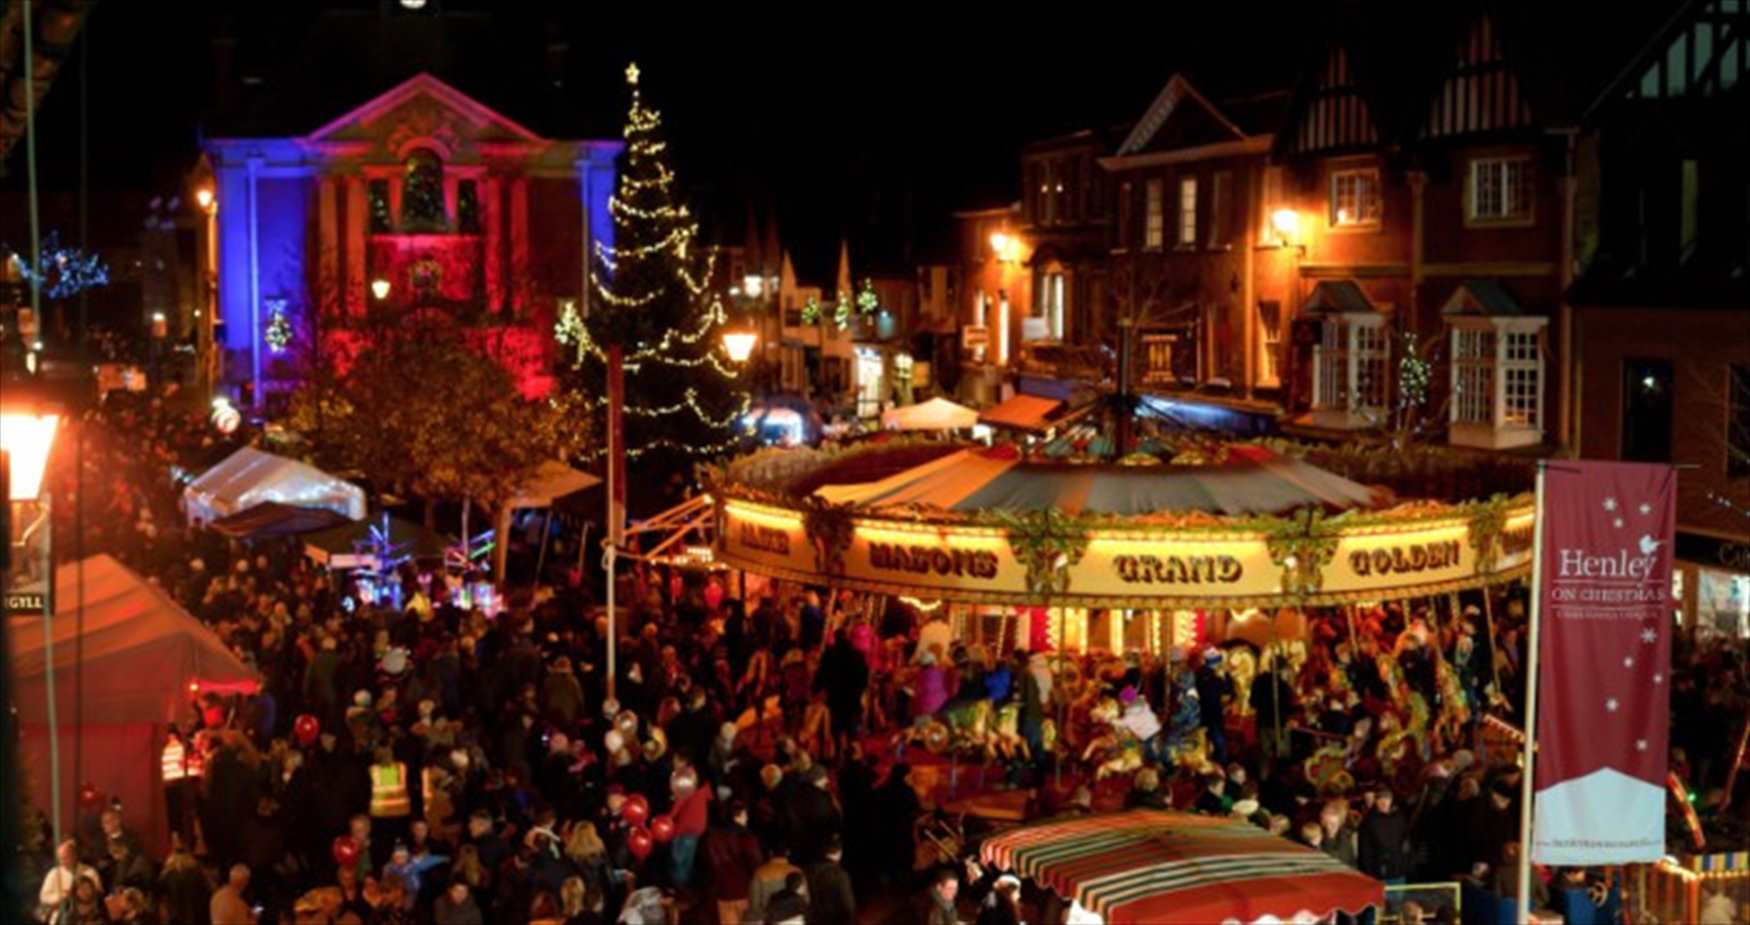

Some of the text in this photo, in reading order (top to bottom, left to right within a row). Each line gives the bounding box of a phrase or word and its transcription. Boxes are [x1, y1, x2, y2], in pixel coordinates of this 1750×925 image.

[1113, 554, 1243, 583] GRAND
[1349, 540, 1460, 577] GOLDEN
[1560, 548, 1657, 588] Henley
[1551, 588, 1577, 600] ON
